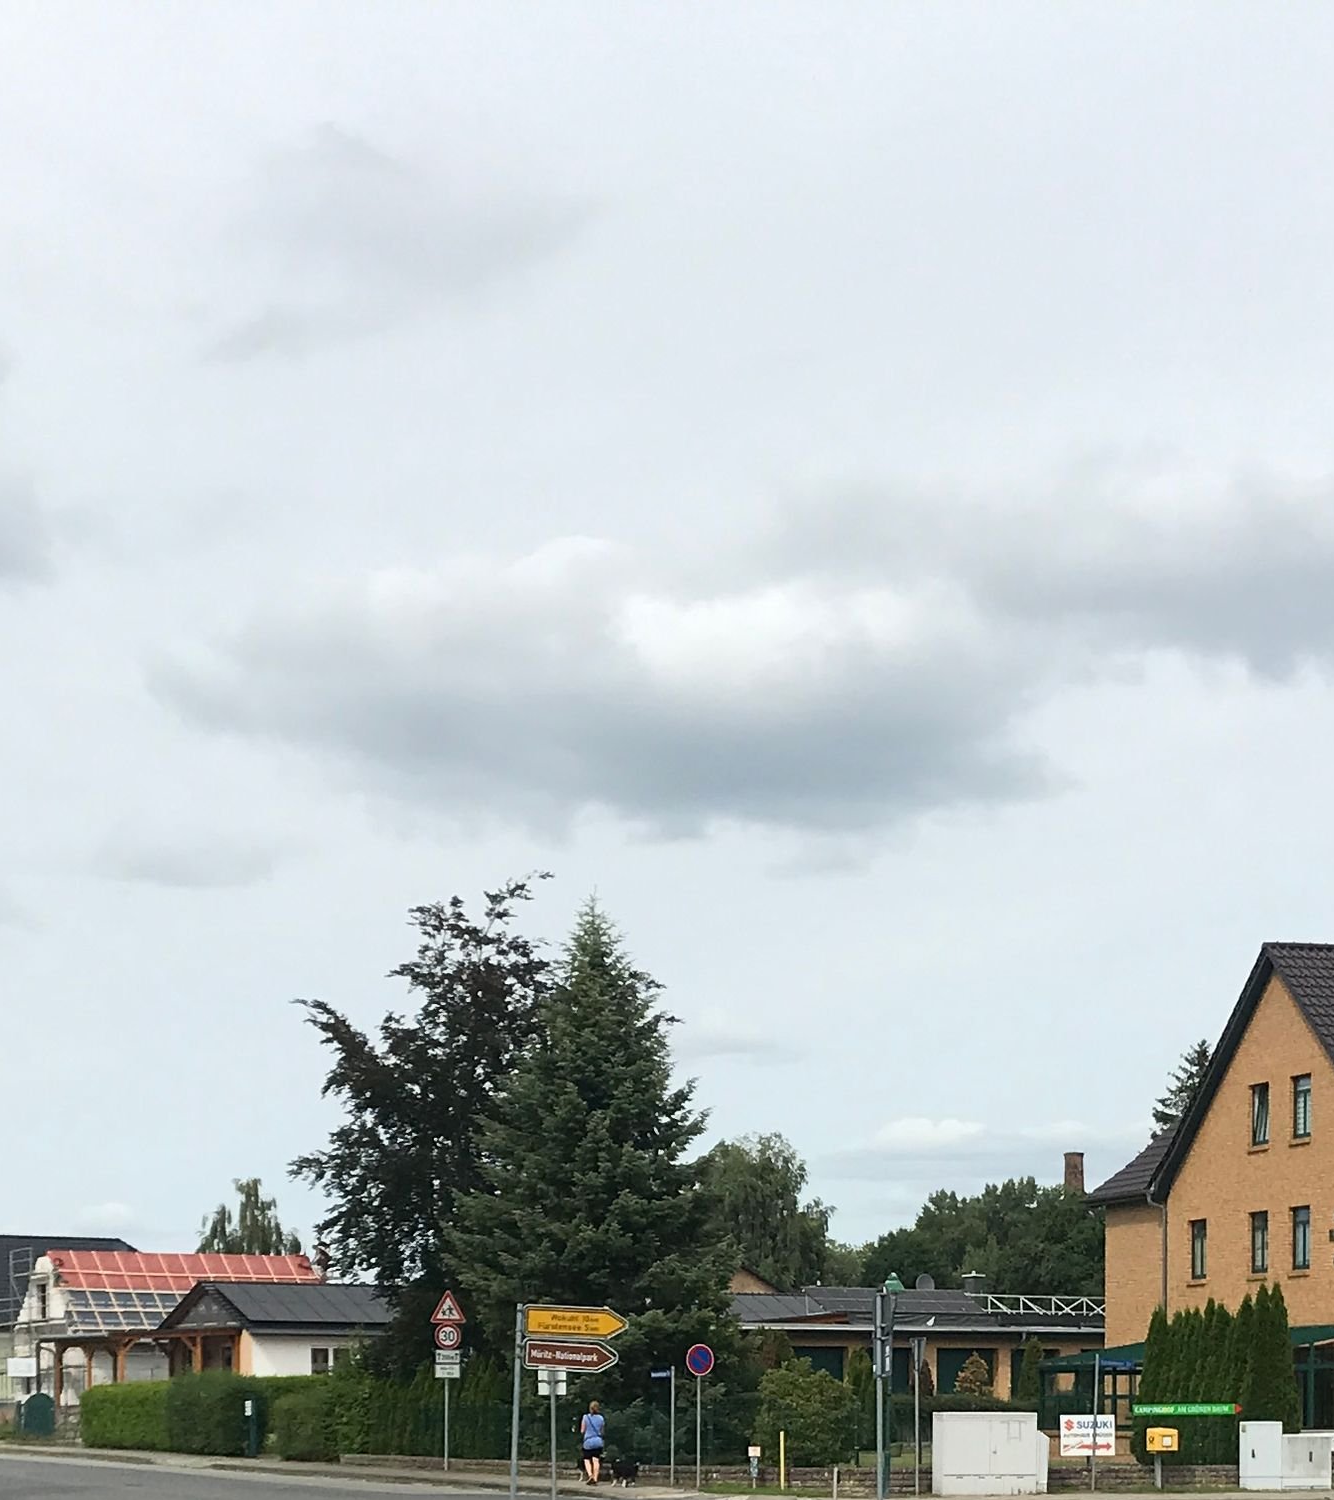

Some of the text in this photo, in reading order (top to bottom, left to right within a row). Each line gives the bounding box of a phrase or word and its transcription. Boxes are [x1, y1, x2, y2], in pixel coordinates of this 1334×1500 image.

[440, 1330, 455, 1341] 30
[530, 1349, 598, 1362] Müritz-Nationalpark
[1076, 1421, 1113, 1429] SUZUKI
